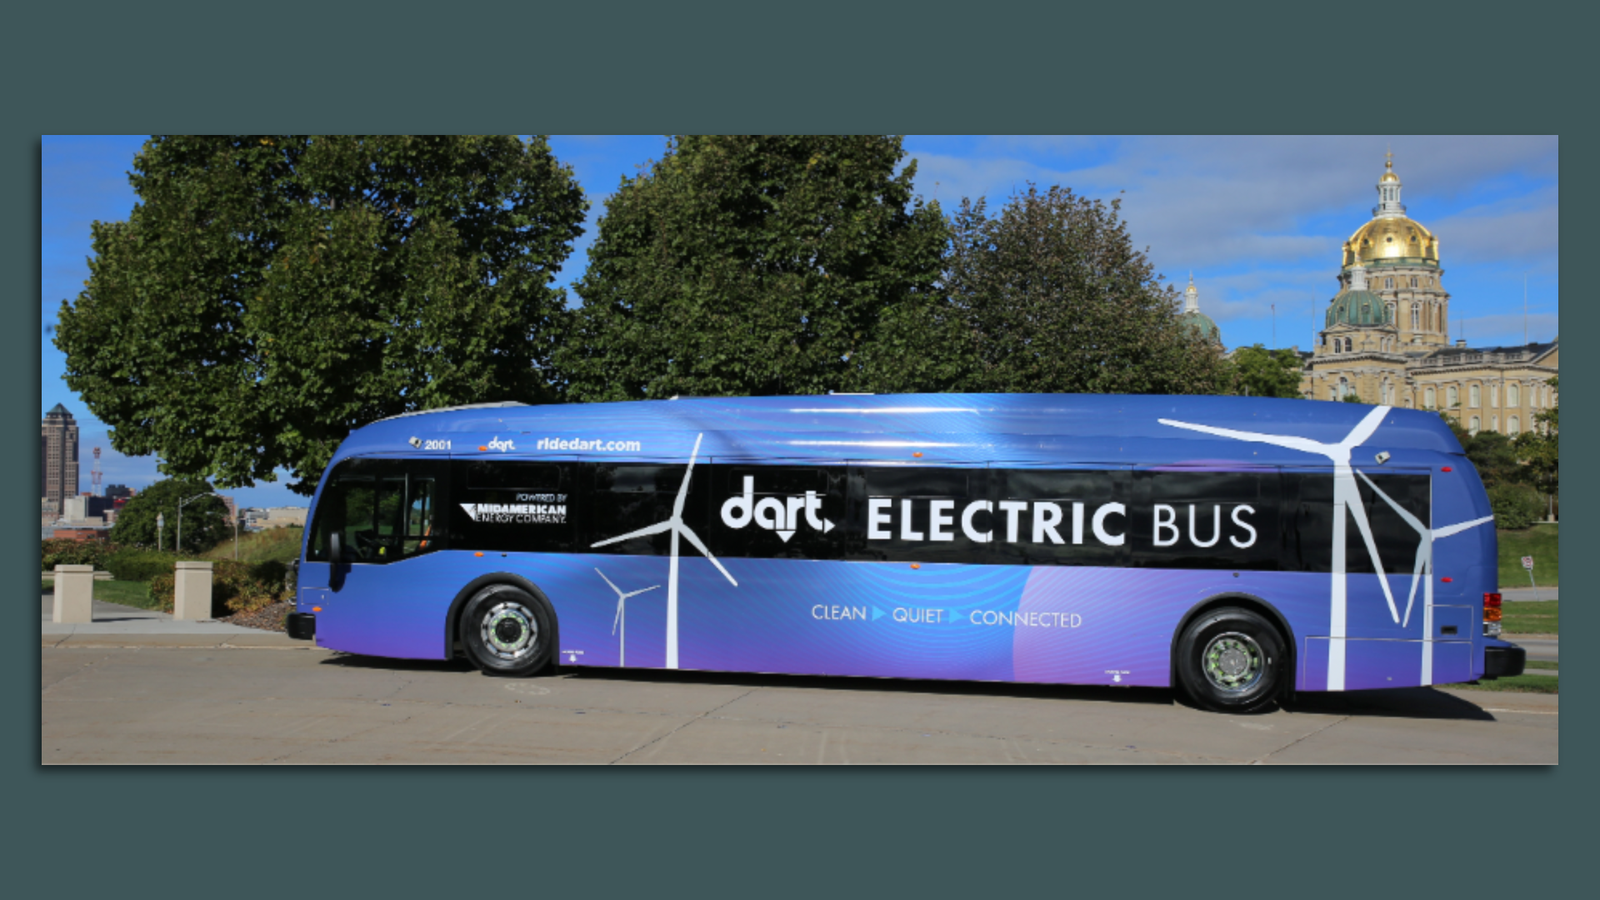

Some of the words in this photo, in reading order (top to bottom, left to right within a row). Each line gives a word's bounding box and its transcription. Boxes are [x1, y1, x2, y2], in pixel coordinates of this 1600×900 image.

[424, 438, 452, 450] 2001
[536, 437, 642, 452] ridedart.com
[557, 494, 568, 502] BY
[477, 503, 567, 514] MIDAMERICAN
[476, 513, 514, 523] ENERGY
[867, 497, 1127, 547] ELECTRIC
[1153, 504, 1258, 549] BUS
[811, 604, 867, 620] CLEAN
[892, 607, 944, 624] QUIET
[969, 609, 1082, 628] CONNECTED
